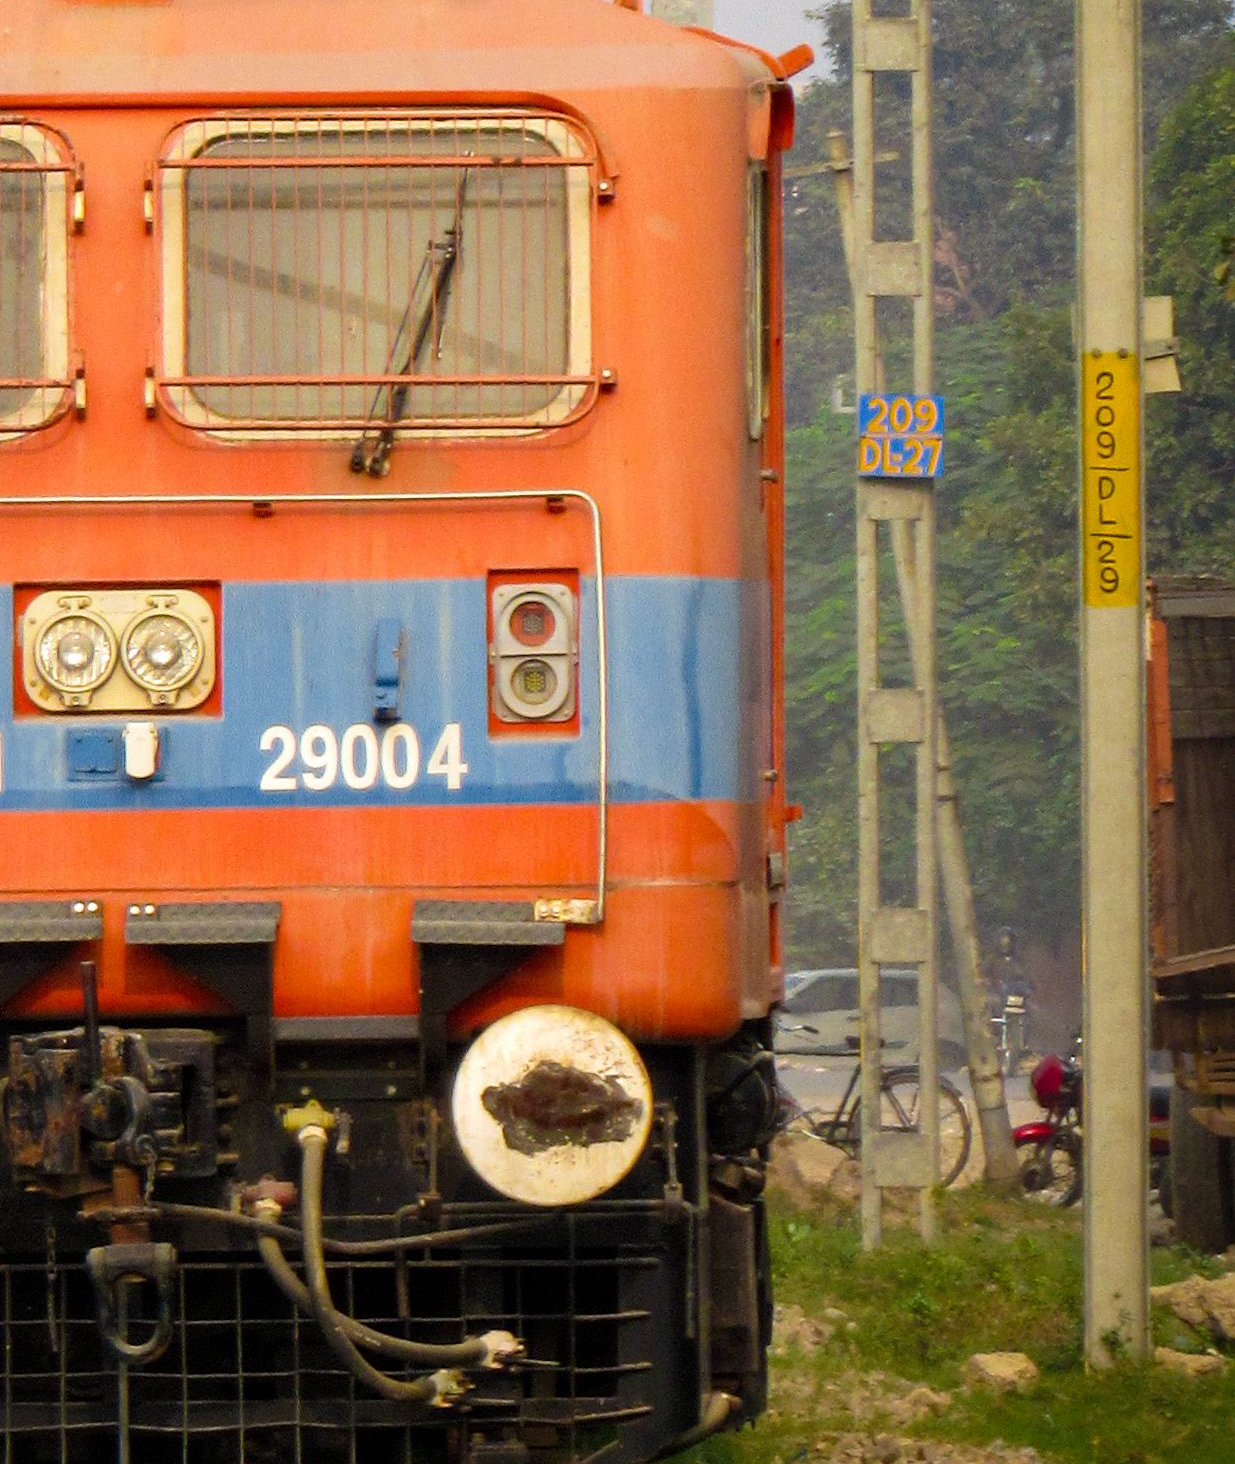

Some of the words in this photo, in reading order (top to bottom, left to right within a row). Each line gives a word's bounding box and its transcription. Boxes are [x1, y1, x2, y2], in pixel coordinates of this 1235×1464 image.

[867, 397, 937, 433] 209
[859, 437, 942, 475] DL-27
[260, 723, 469, 792] 29004
